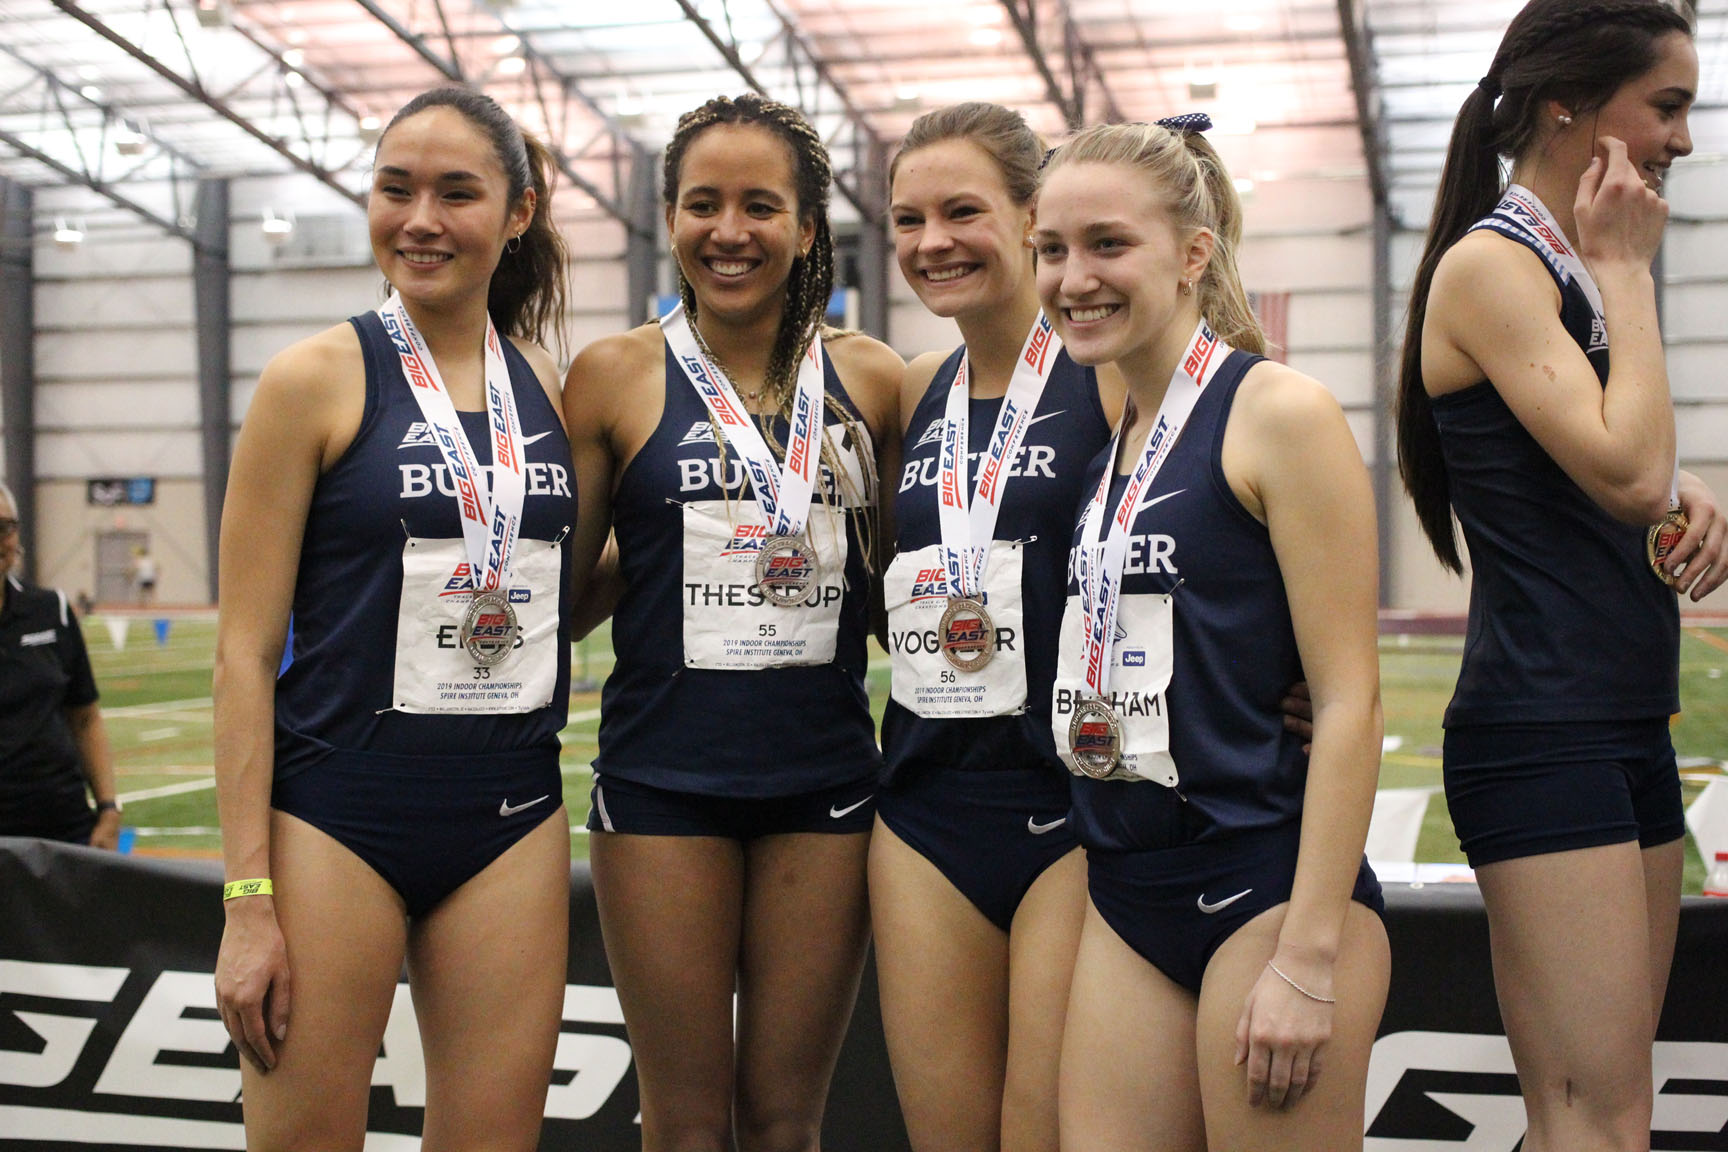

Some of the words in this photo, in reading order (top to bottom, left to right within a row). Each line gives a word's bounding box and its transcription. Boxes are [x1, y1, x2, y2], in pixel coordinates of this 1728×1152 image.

[899, 446, 1056, 494] BUTER
[399, 463, 572, 498] BUER
[770, 556, 806, 568] BIG
[765, 568, 813, 578] EAST
[511, 591, 528, 601] Jeep
[912, 583, 948, 597] EAS
[477, 614, 506, 626] BIG
[951, 619, 981, 632] BIG
[472, 626, 514, 636] EAST
[758, 624, 777, 637] 55
[946, 630, 989, 642] EAST
[1125, 654, 1144, 664] Jeep
[473, 666, 491, 680] 33
[940, 670, 956, 683] 56
[479, 682, 522, 690] CHAMPIONSHIPS
[946, 686, 986, 694] CHAMPIONSHIPS
[440, 692, 456, 700] SPIRE
[458, 692, 486, 700] INSTITUTE
[511, 691, 519, 699] OH
[974, 695, 983, 703] OH
[1056, 689, 1161, 717] BHAM
